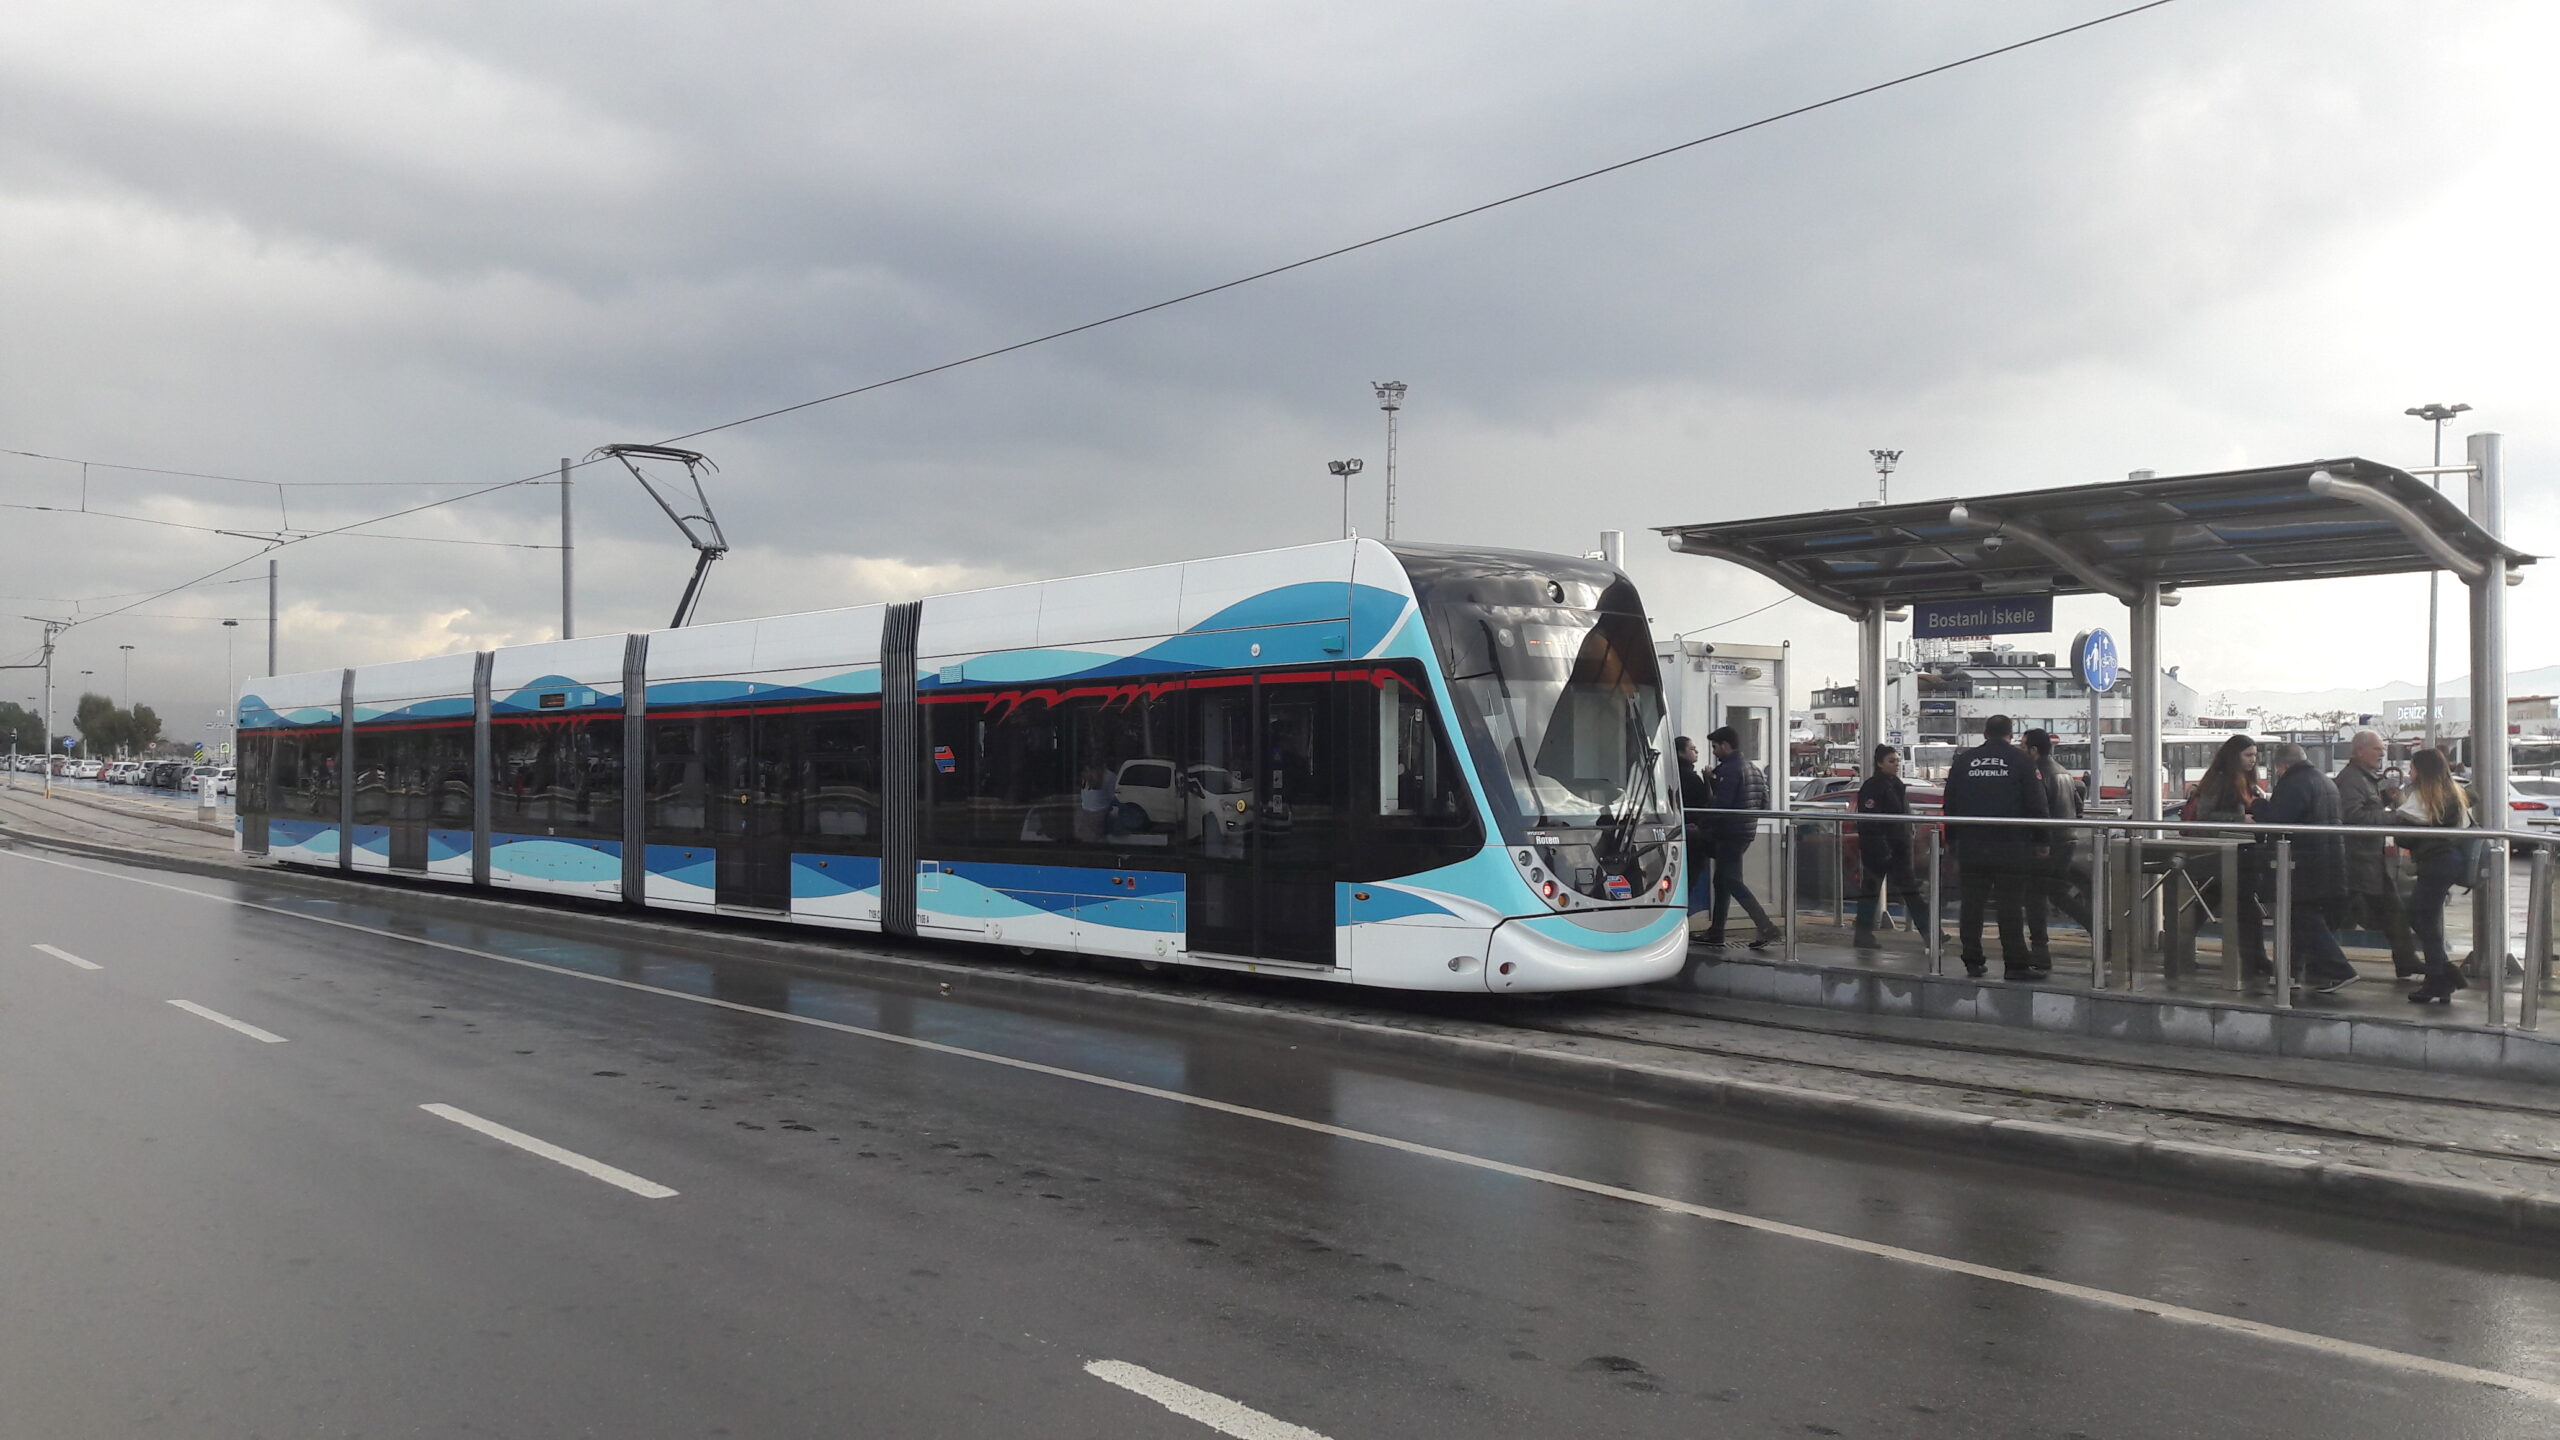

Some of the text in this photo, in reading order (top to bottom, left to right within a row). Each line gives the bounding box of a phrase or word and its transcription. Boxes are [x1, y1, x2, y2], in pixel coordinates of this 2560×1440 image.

[1929, 605, 2035, 628] Bostanlı İskele
[1970, 757, 2009, 767] ÖZEL
[1968, 768, 2009, 777] GÜVENLİK
[1535, 835, 1560, 845] Rotem
